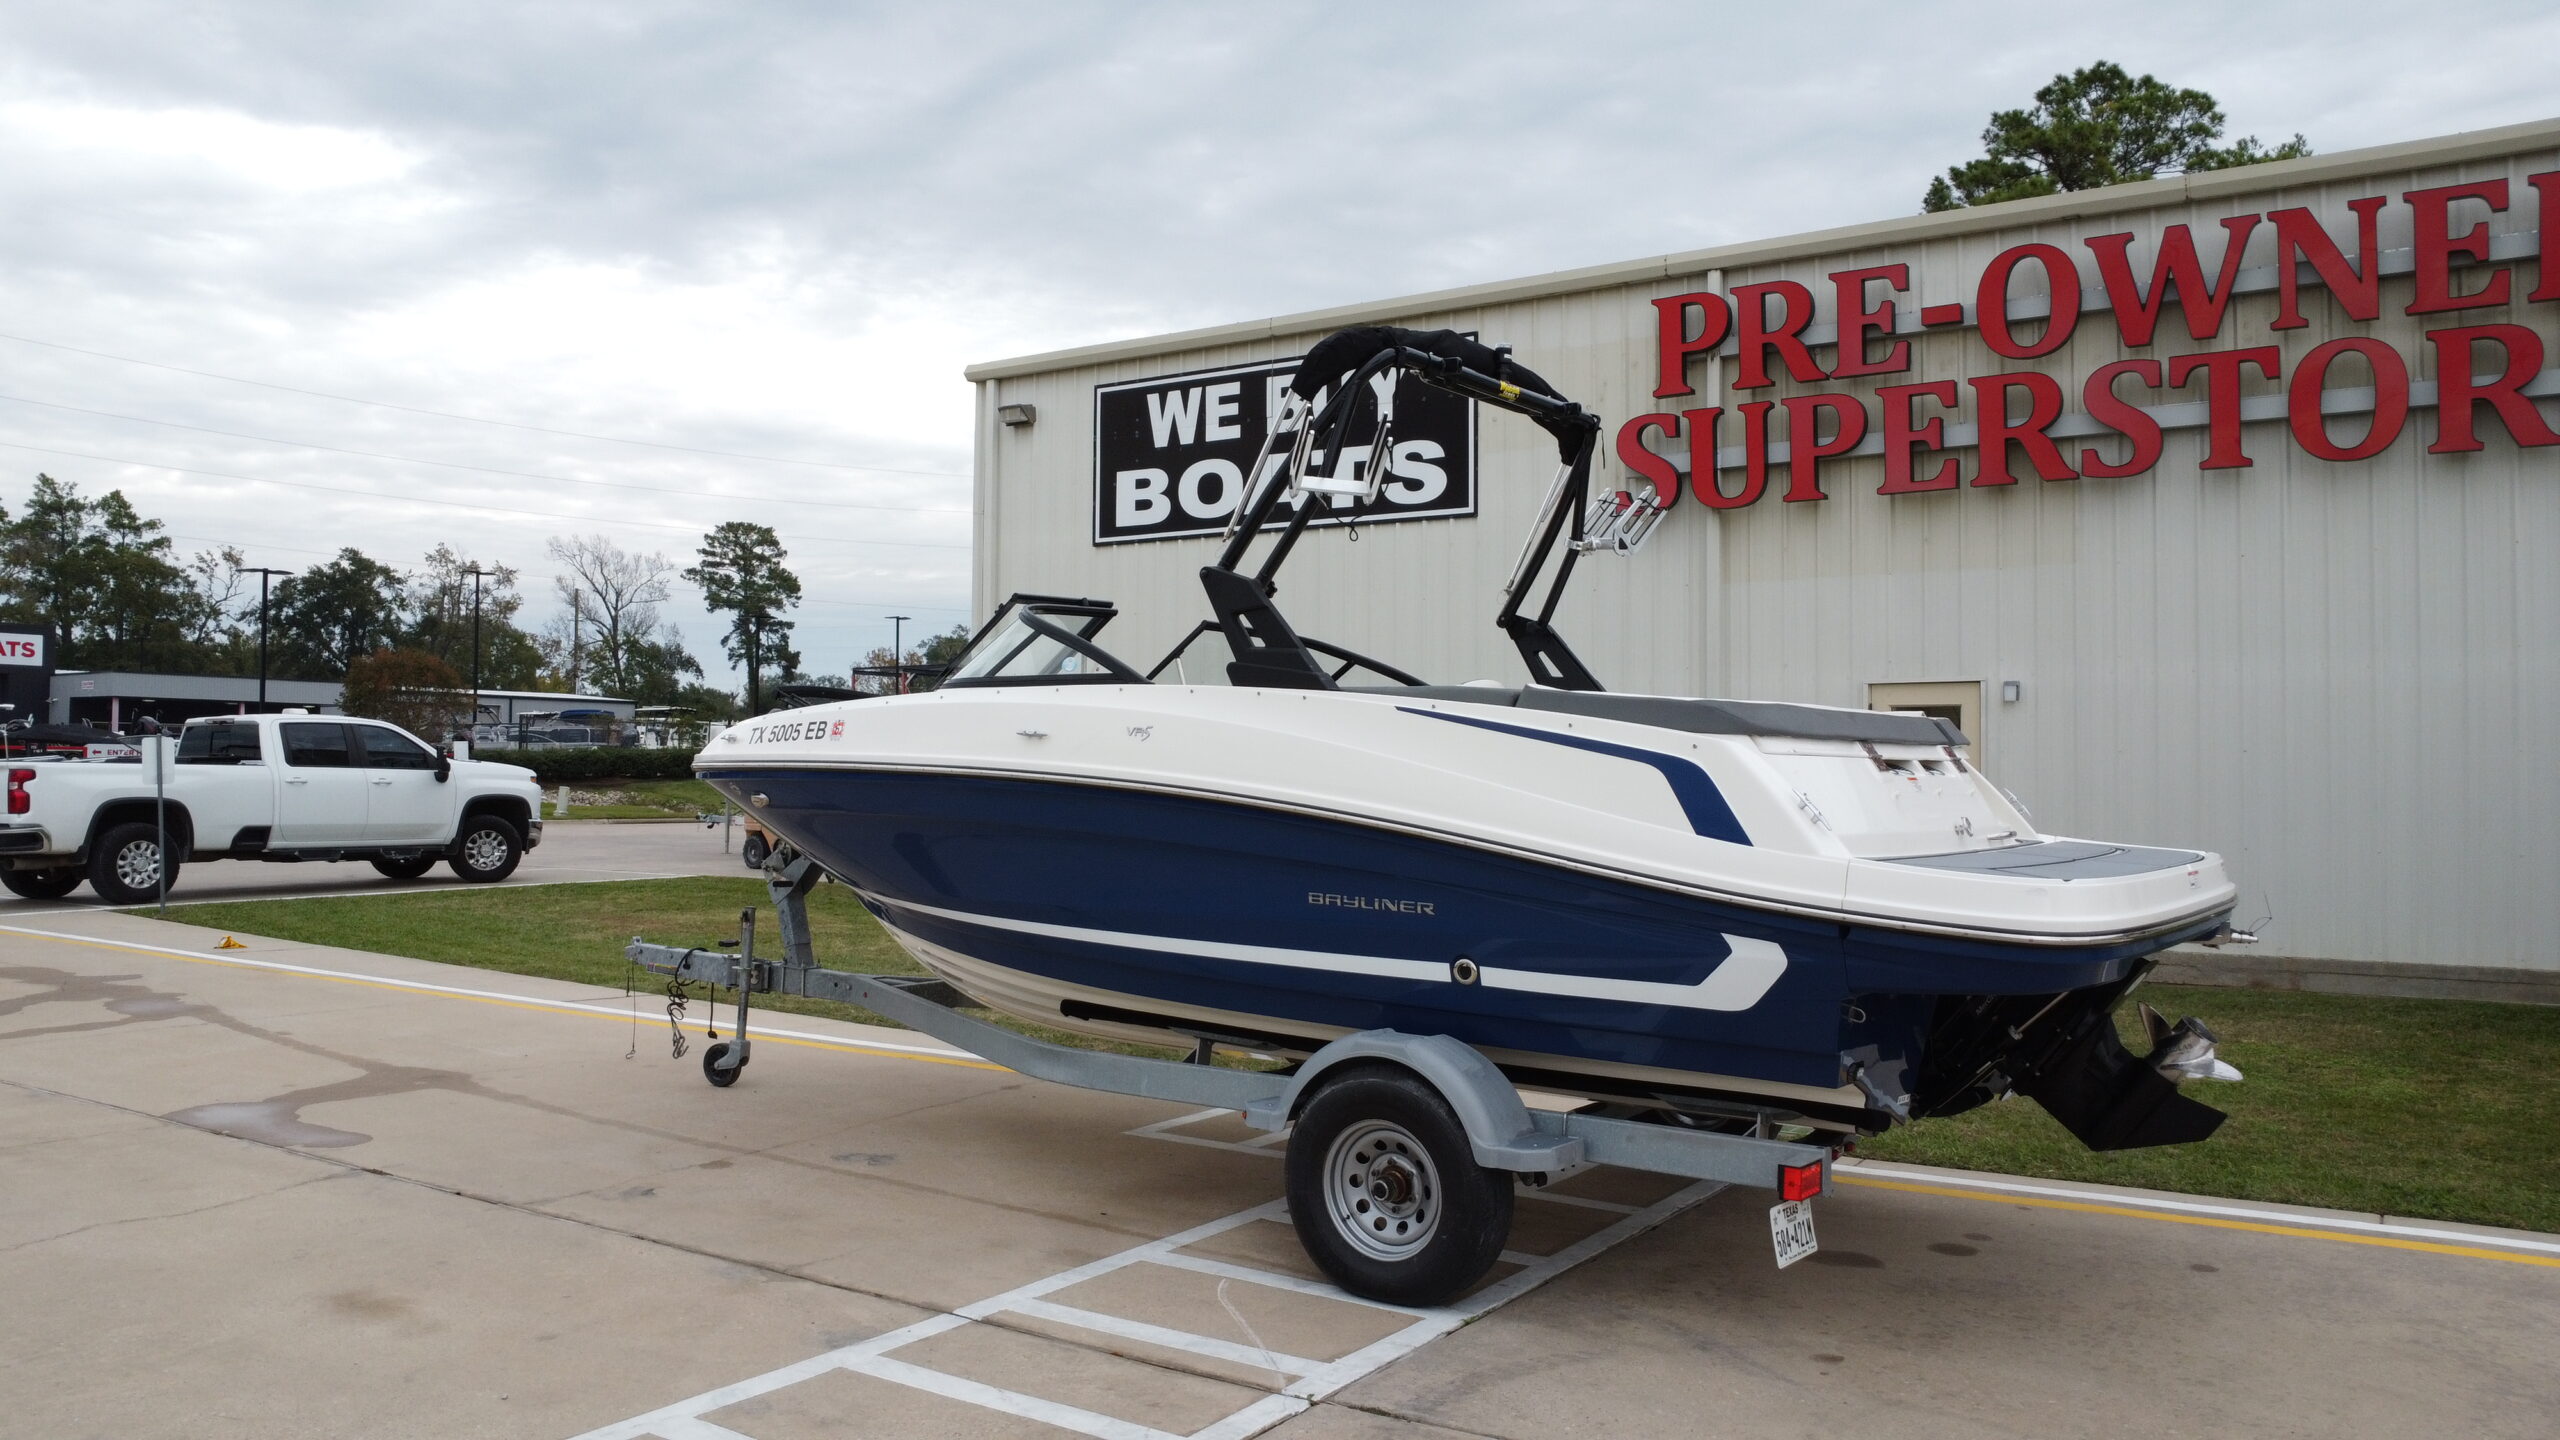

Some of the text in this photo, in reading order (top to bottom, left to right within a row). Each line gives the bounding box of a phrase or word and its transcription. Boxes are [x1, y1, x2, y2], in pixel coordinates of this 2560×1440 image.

[1652, 171, 2560, 399] PRE-OWNE
[1147, 366, 1405, 448] WE BY
[1616, 323, 2560, 516] SUPERSTOR
[749, 726, 768, 744] TX
[768, 723, 802, 743] 5005
[805, 721, 827, 740] EB
[1308, 892, 1435, 915] BAYLINER
[1782, 1203, 1799, 1219] TEXAS
